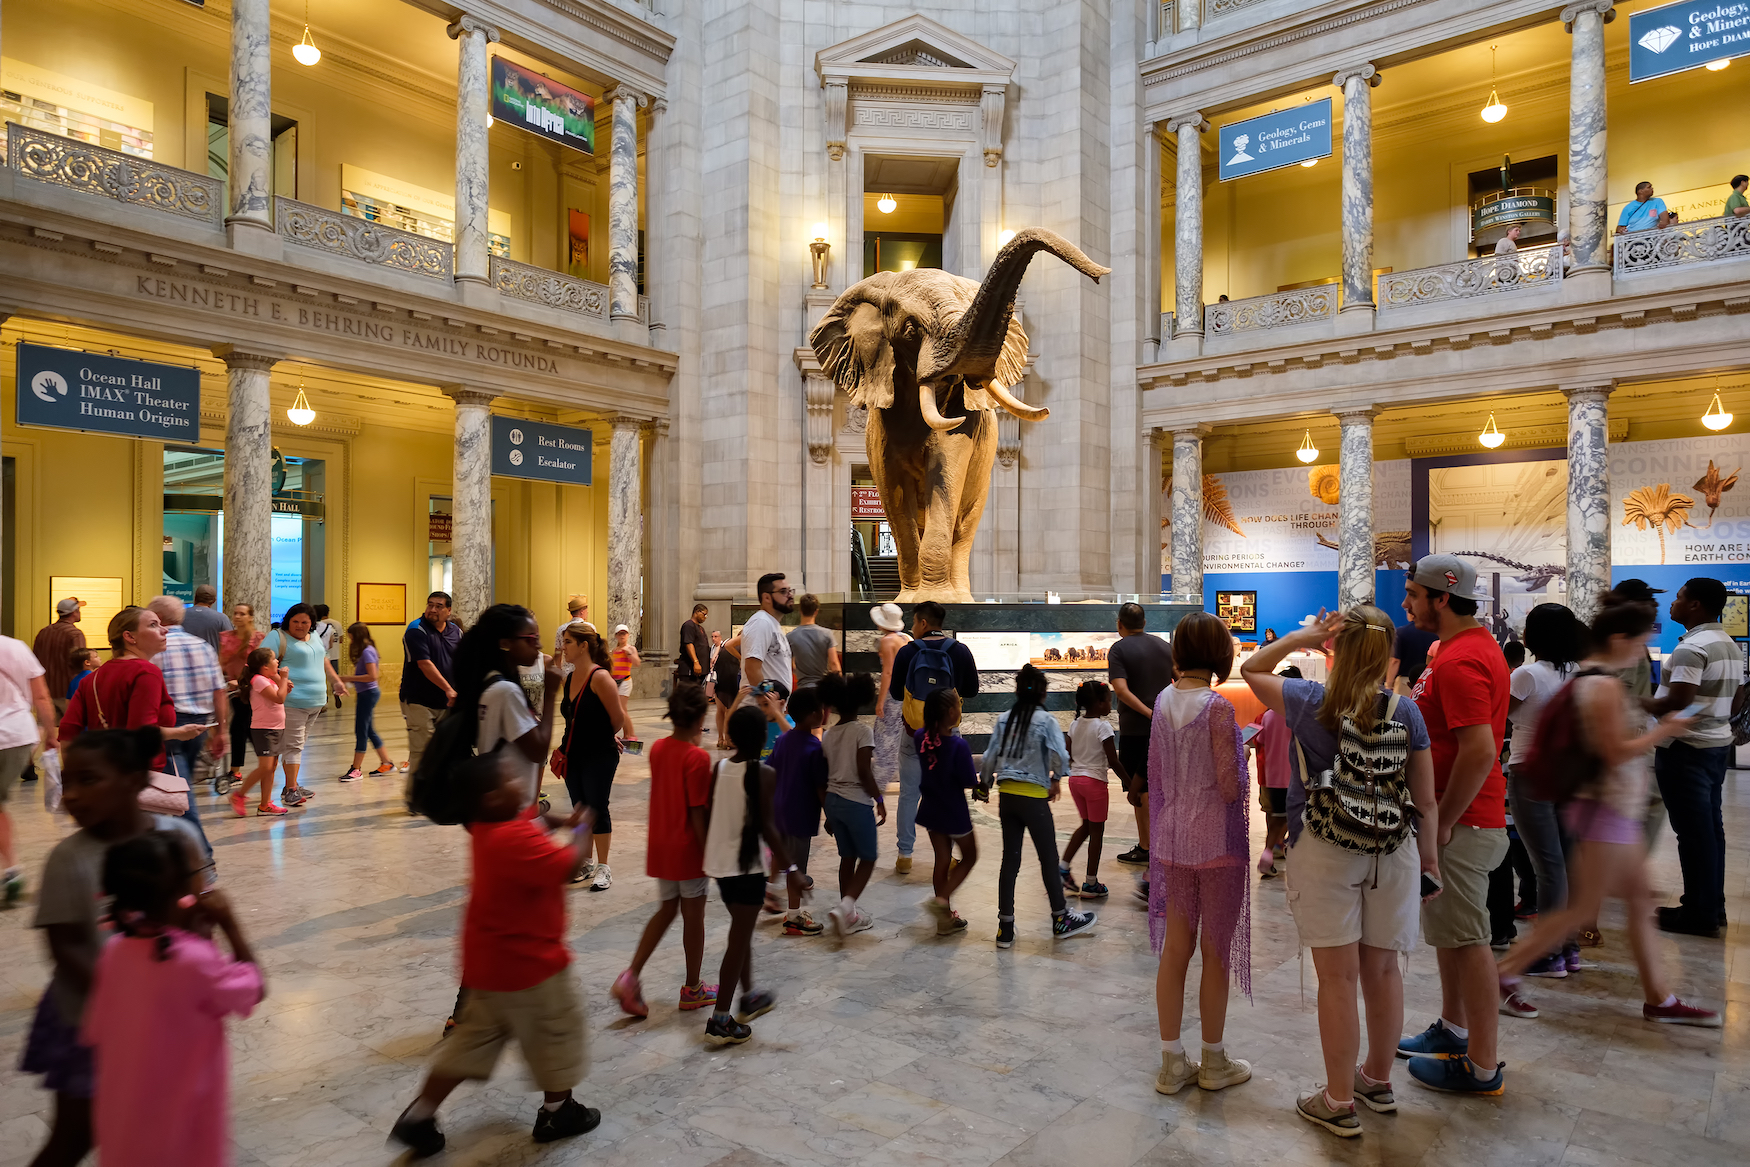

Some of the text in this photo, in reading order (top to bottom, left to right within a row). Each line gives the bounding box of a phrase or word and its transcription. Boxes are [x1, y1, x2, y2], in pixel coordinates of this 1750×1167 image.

[1688, 3, 1748, 24] Geology,
[1688, 26, 1702, 38] &
[1688, 38, 1720, 53] HOPE
[1258, 119, 1326, 142] Geology, Gems
[1258, 132, 1310, 154] & Minerals
[1481, 200, 1538, 217] HOPE DIAMOND
[136, 276, 558, 374] KENNETH E. BEHRING FAMILY ROTUNDA
[80, 368, 161, 391] Ocean Hall
[134, 392, 190, 410] Theater
[80, 402, 190, 428] Human Origins
[538, 436, 584, 452] Rest Rooms
[538, 456, 576, 470] Escalator
[280, 502, 300, 512] HALL
[1265, 514, 1288, 522] DOES
[1290, 521, 1336, 529] THROUGH
